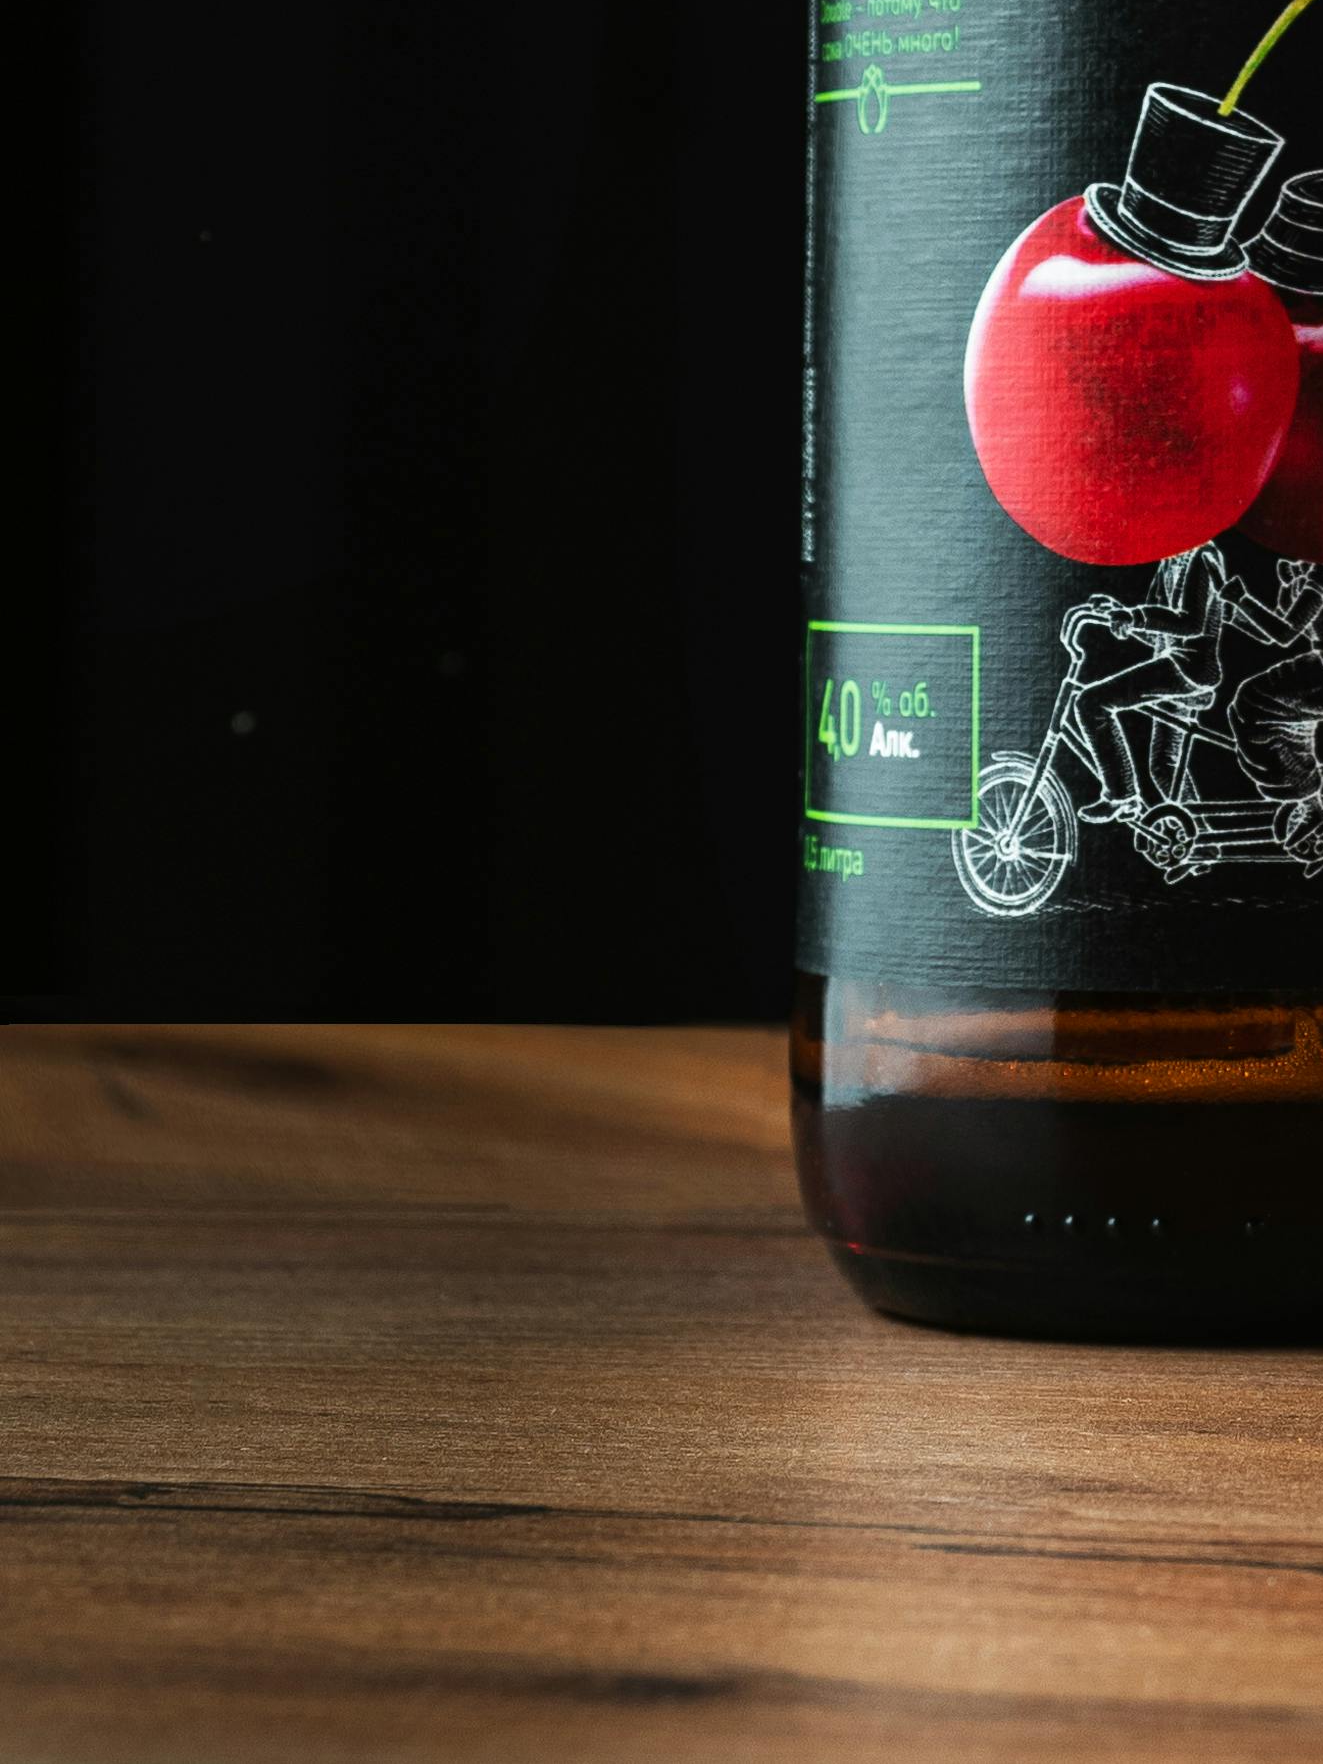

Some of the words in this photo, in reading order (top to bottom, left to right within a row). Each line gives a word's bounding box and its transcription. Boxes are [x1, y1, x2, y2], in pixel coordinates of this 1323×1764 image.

[898, 24, 960, 53] много!
[818, 678, 861, 762] 4,0
[899, 681, 937, 717] об.
[869, 720, 921, 759] Алк.
